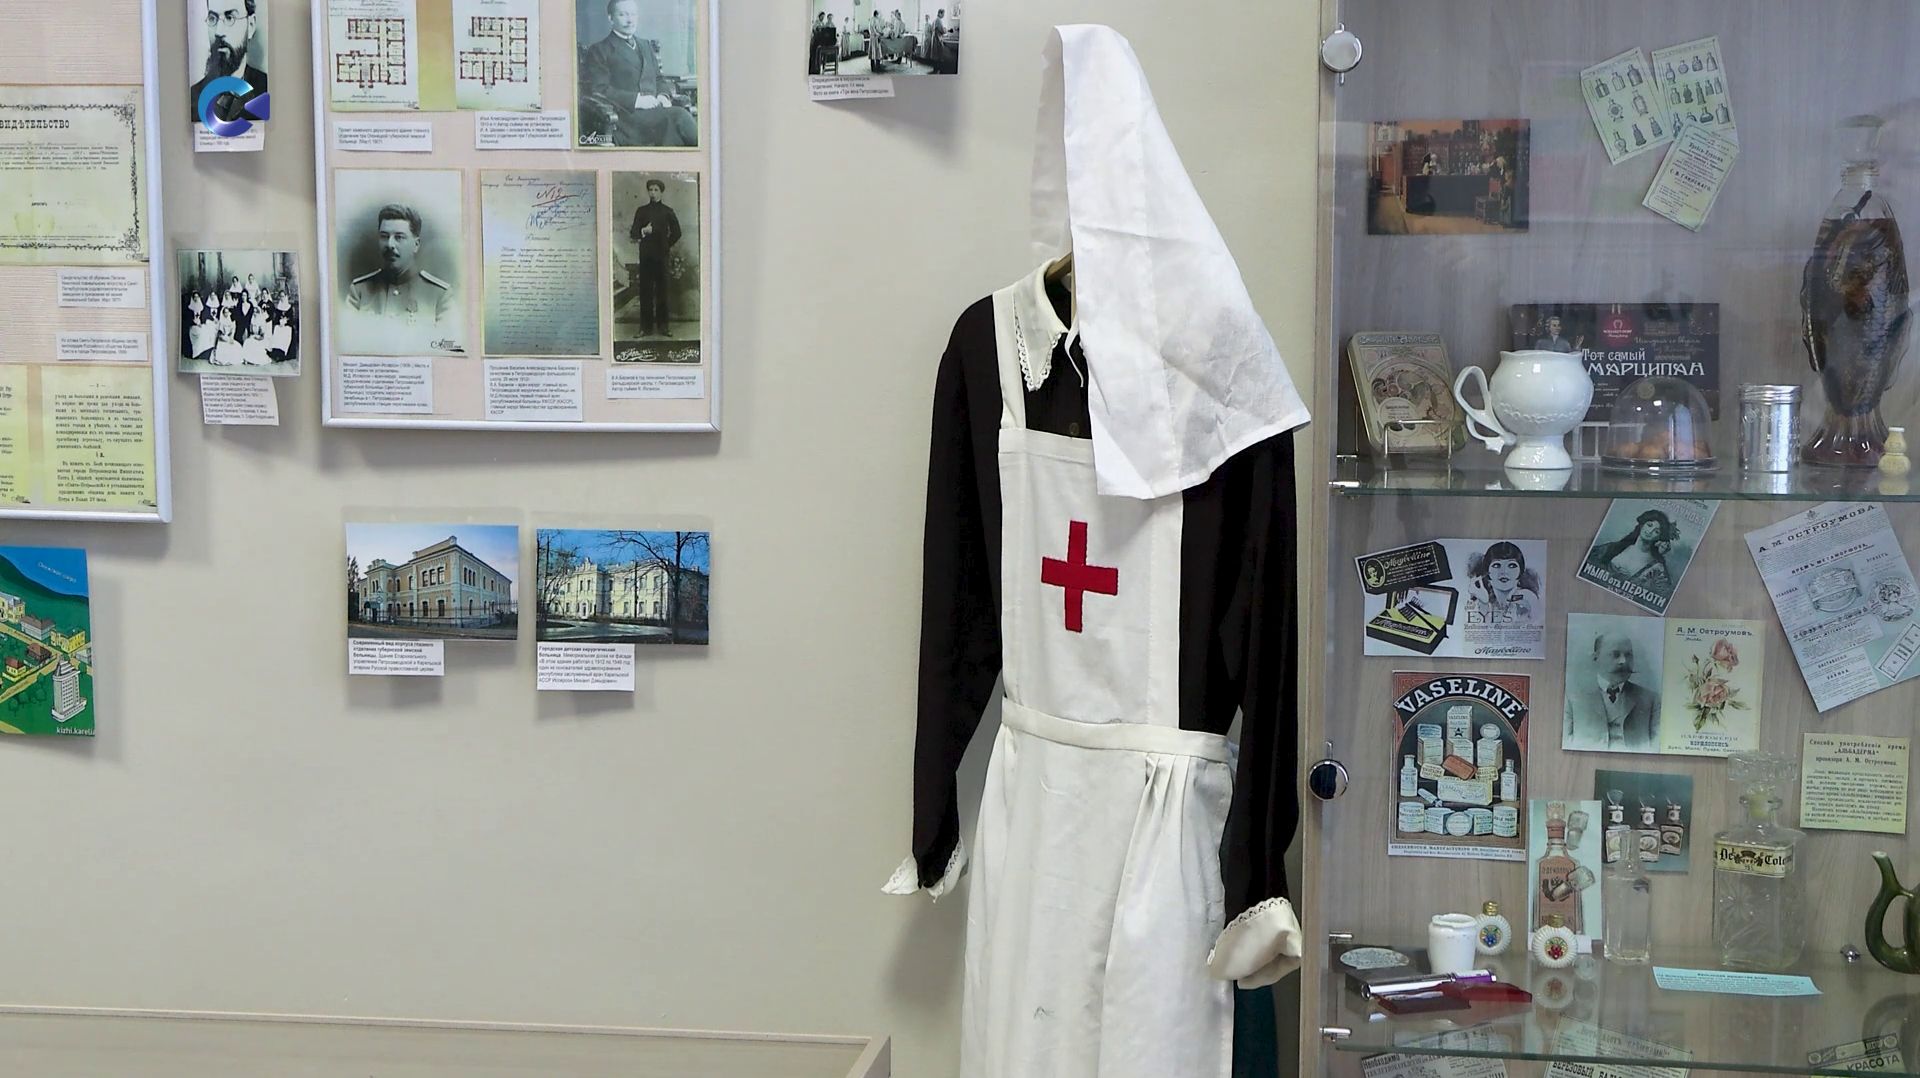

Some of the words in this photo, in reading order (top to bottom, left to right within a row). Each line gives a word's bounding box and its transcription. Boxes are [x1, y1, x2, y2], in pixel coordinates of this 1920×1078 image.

[1587, 361, 1705, 377] МАРЦИПАН
[1787, 504, 1876, 542] ОСТРОУМОВА
[1583, 562, 1609, 582] МЫЛО
[1621, 580, 1667, 608] ПЕРХОТИ
[1467, 610, 1513, 624] EYES
[1847, 1054, 1900, 1072] КРАСОТА
